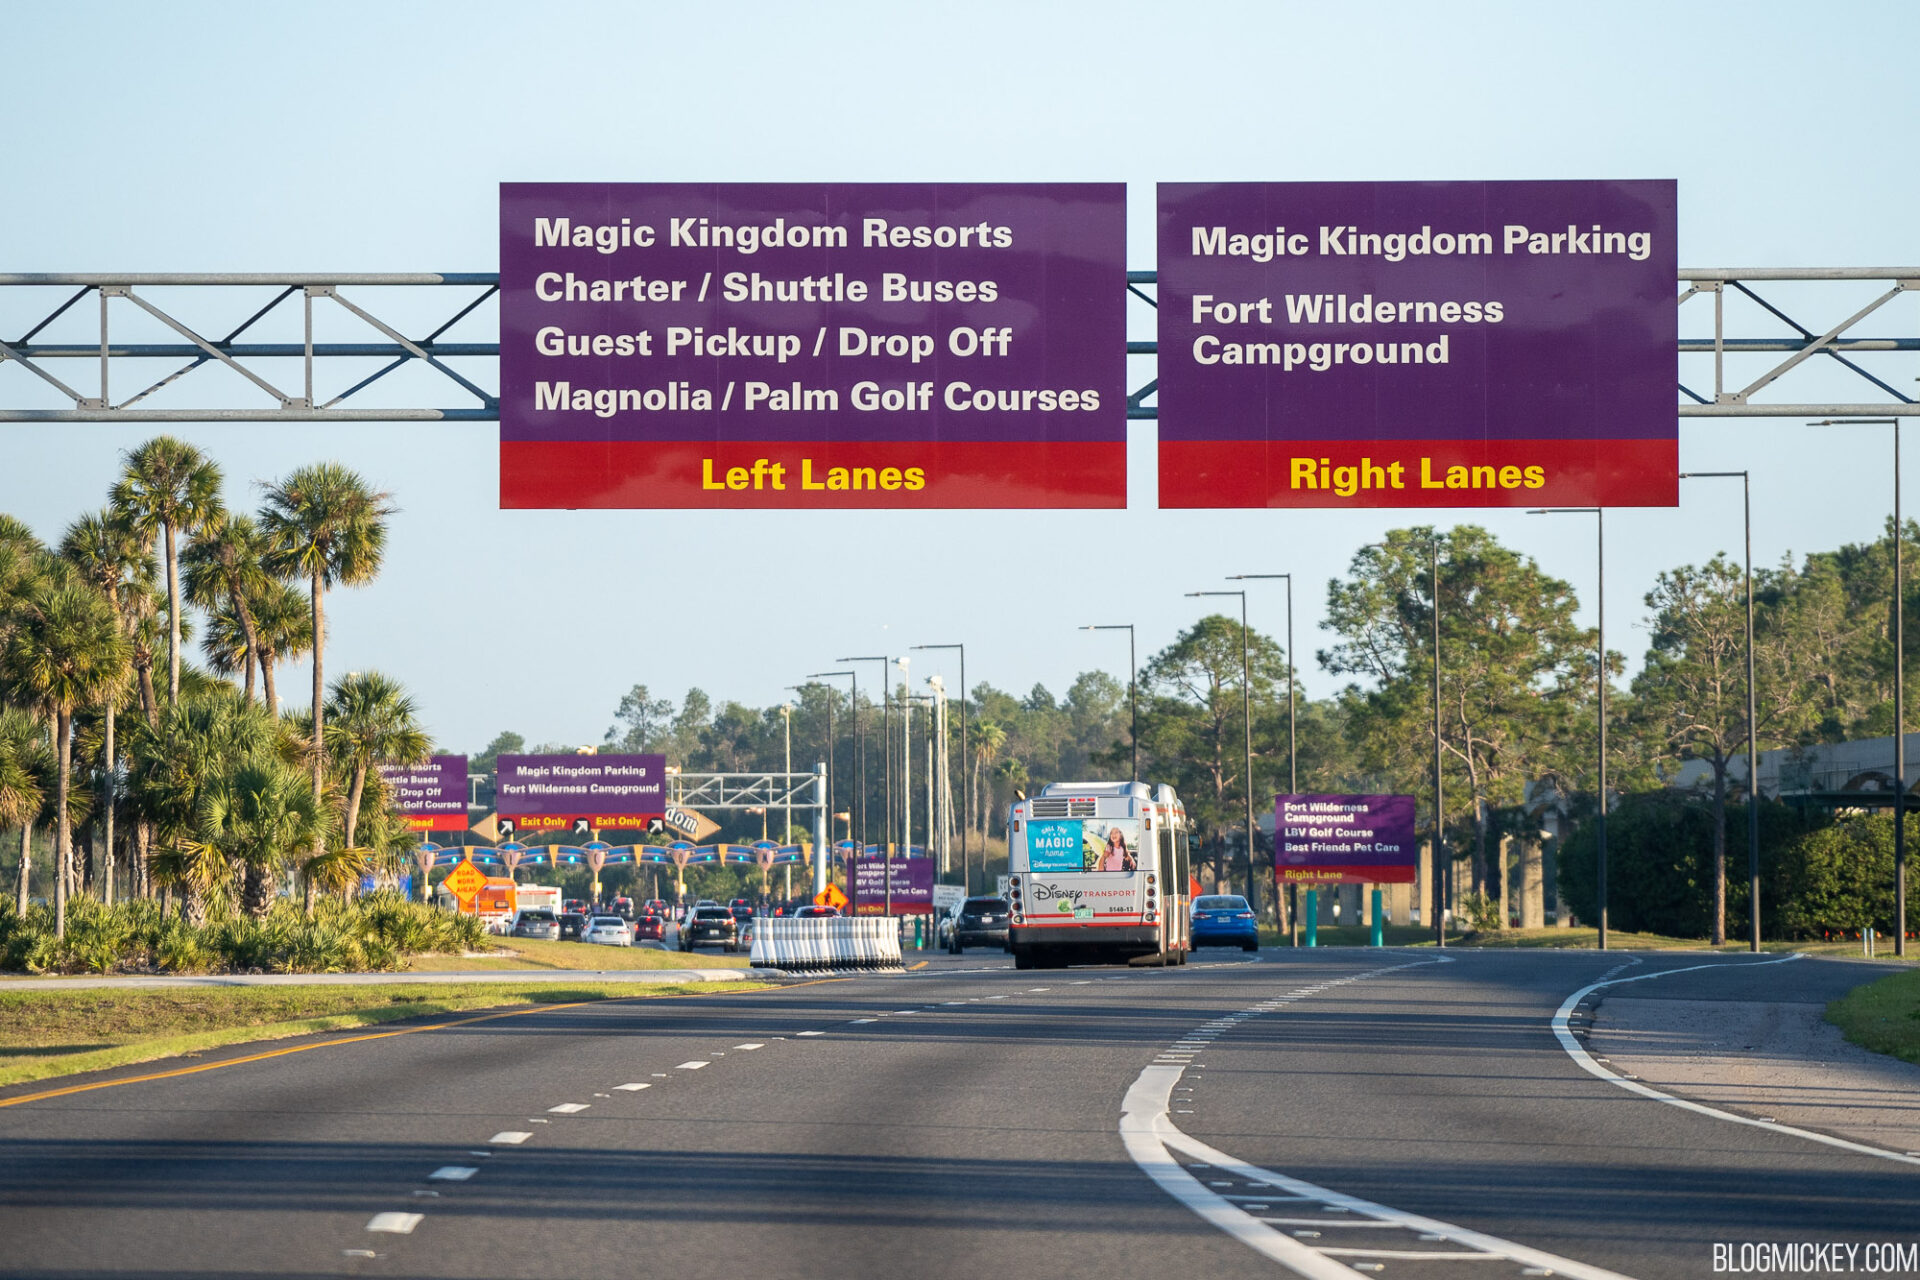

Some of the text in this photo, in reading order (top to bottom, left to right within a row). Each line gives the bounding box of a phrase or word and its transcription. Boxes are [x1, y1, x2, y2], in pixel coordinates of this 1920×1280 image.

[535, 218, 1012, 254] Magic Kingdom Resorts
[1192, 225, 1650, 262] Magic Kingdom Parking
[536, 272, 997, 302] Charter / Shuttle Buses
[1193, 295, 1503, 323] Fort Wilderness
[536, 327, 1012, 363] Guest Pickup / Drop Off
[1193, 335, 1448, 371] Campground
[536, 381, 1099, 417] Magnolia / Palm Golf Courses
[703, 459, 925, 490] Left Lanes
[1291, 458, 1544, 496] Right Lanes
[516, 766, 646, 778] Magic Kingdom Parking
[384, 776, 438, 784] uttle Buses
[401, 788, 423, 797] Drop
[426, 788, 442, 796] Off
[503, 783, 660, 796] Fort Wilderness Campground
[403, 800, 423, 808] Golf
[425, 800, 462, 808] Courses
[1284, 802, 1368, 812] Fort Wilderness
[405, 818, 434, 827] head
[521, 816, 567, 827] Exit Only
[596, 816, 642, 827] Exit Only
[1284, 813, 1354, 824] Campground
[1285, 827, 1374, 837] LBV Golf Course
[1035, 837, 1074, 848] MAGIC
[1285, 842, 1400, 852] Best Friends Pet Care
[1285, 870, 1342, 880] Right Lane
[1030, 883, 1082, 904] Disney
